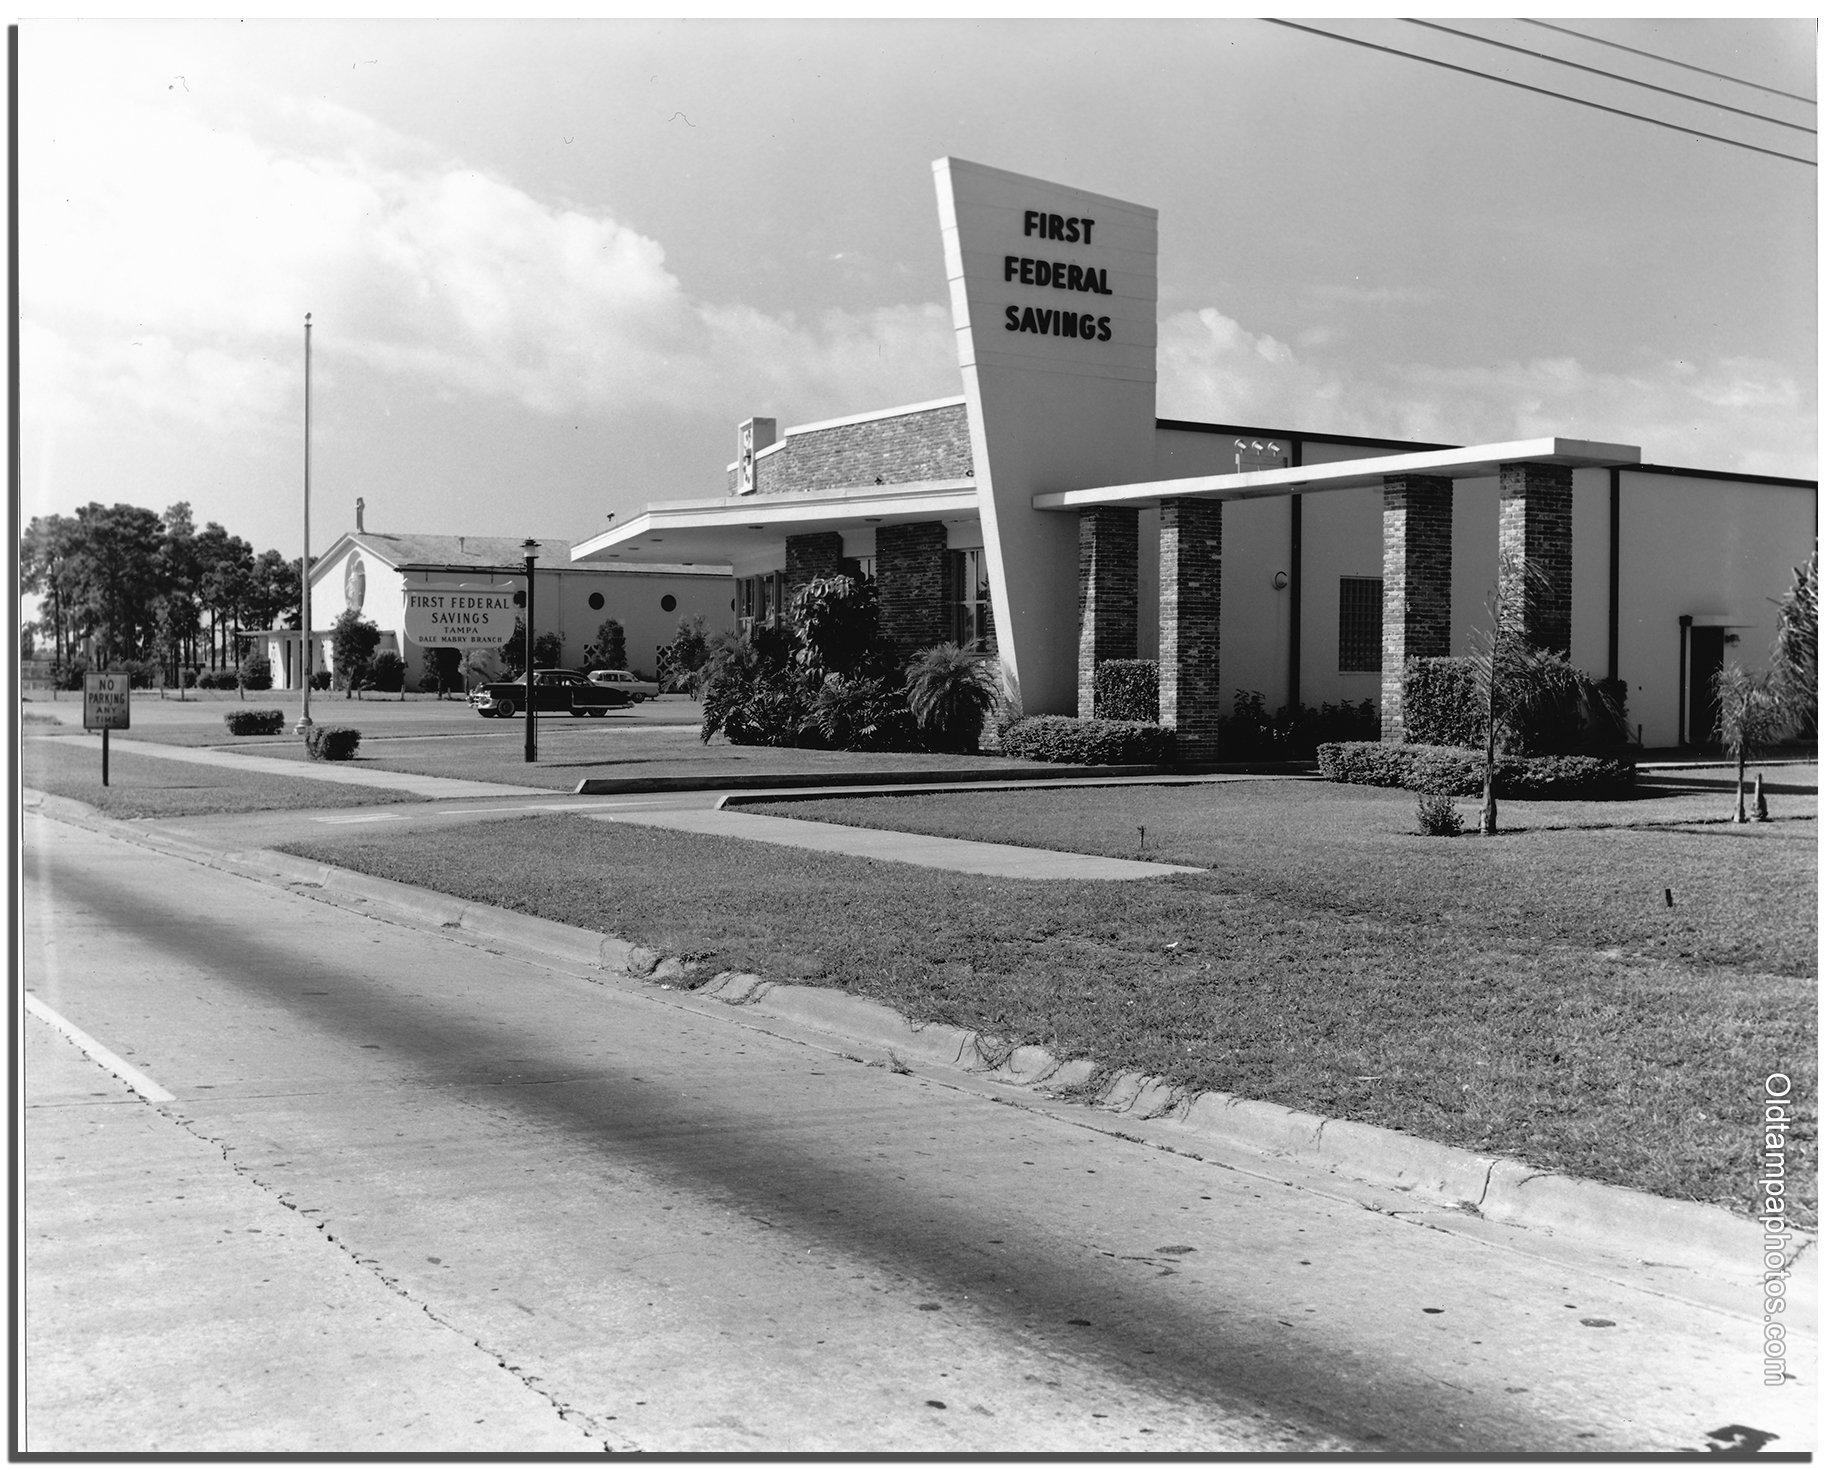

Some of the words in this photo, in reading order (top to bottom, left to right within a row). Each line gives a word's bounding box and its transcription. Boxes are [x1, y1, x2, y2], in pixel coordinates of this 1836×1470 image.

[1024, 210, 1095, 245] FIRST
[1004, 255, 1113, 295] FEDERAL
[1005, 305, 1112, 341] SAVINGS
[410, 596, 444, 608] FIRST
[451, 597, 510, 609] FEDERAL
[431, 612, 489, 624] SAVINGS
[444, 626, 479, 634] TAMPA
[419, 635, 437, 643] DALE
[99, 679, 114, 691] NO
[88, 693, 125, 704] PARKING
[96, 706, 117, 714] ANY
